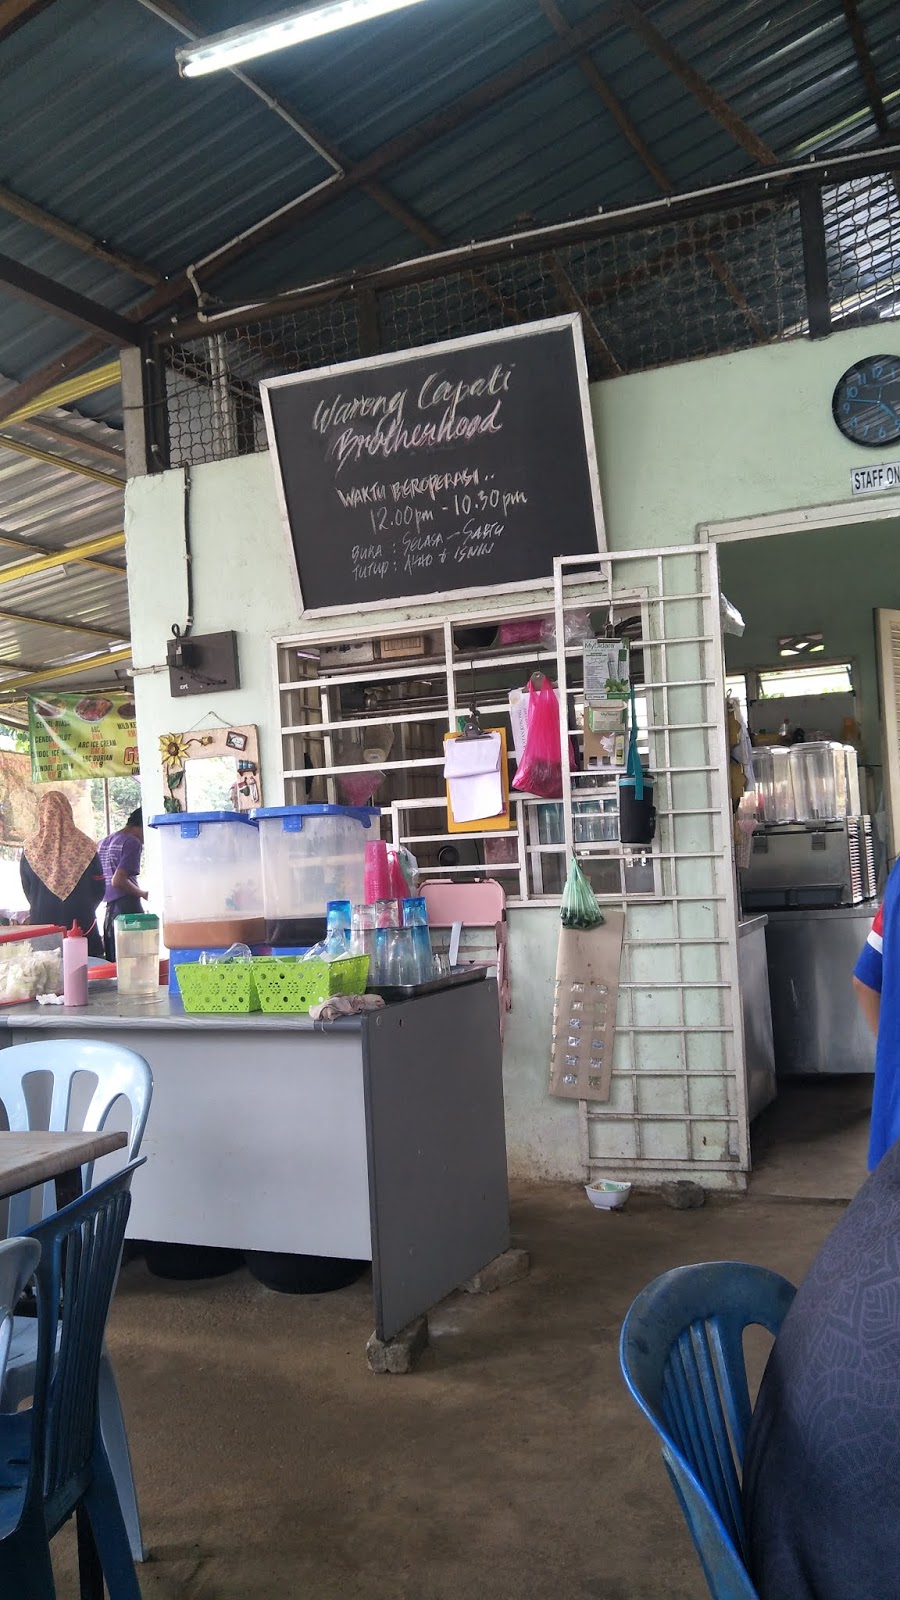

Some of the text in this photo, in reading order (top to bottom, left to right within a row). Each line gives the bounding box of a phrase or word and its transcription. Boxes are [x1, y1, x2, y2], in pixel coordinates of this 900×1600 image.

[417, 363, 516, 424] Capati
[331, 399, 503, 479] Brotherhood
[335, 481, 386, 508] WAKTU
[855, 469, 883, 490] STAFF
[369, 505, 434, 535] 12.00pm
[453, 488, 528, 517] 10.30pm
[402, 530, 444, 556] SELASA
[462, 517, 505, 547] SABTU
